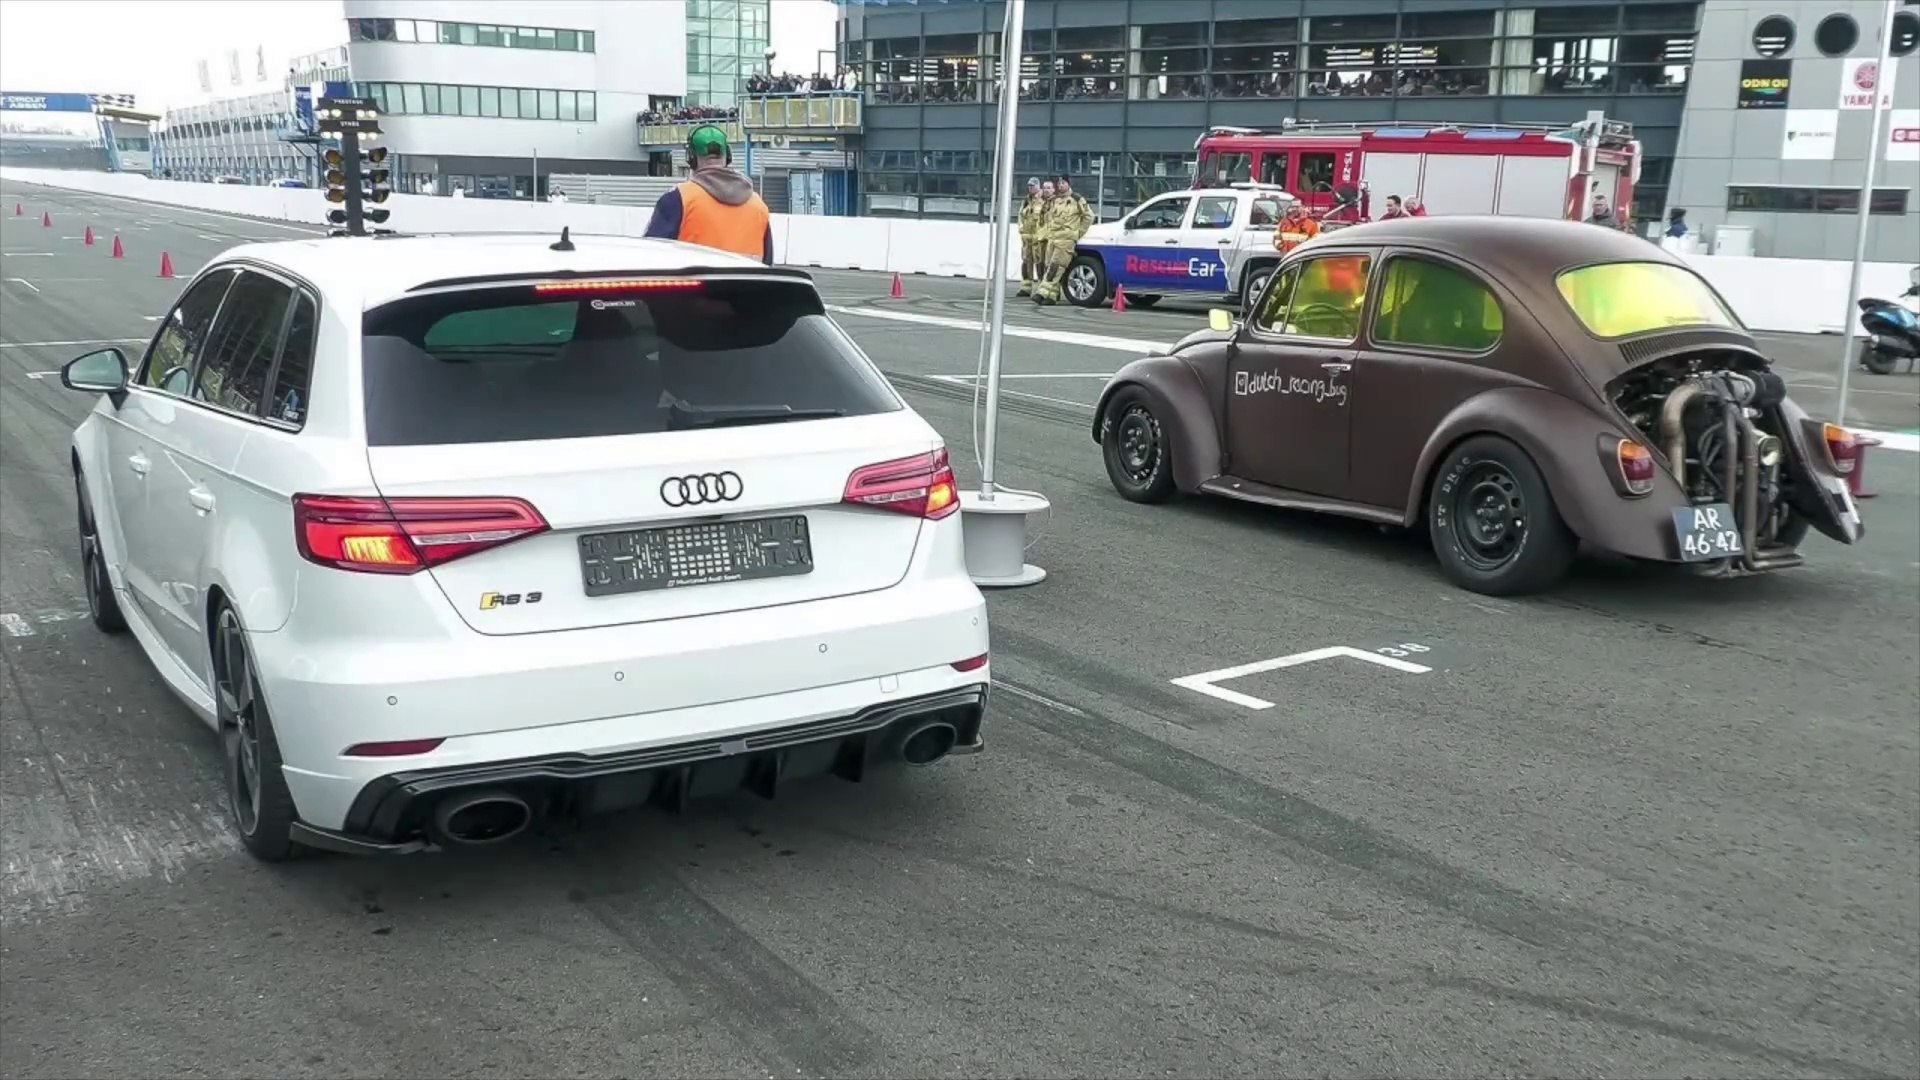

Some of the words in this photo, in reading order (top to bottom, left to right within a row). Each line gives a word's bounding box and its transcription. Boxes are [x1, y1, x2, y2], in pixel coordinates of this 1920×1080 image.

[1843, 94, 1890, 106] YAMAA
[1694, 507, 1722, 530] AR
[1684, 530, 1741, 556] 46-42
[487, 593, 521, 607] RS
[525, 591, 543, 604] 3
[1376, 642, 1431, 657] 38
